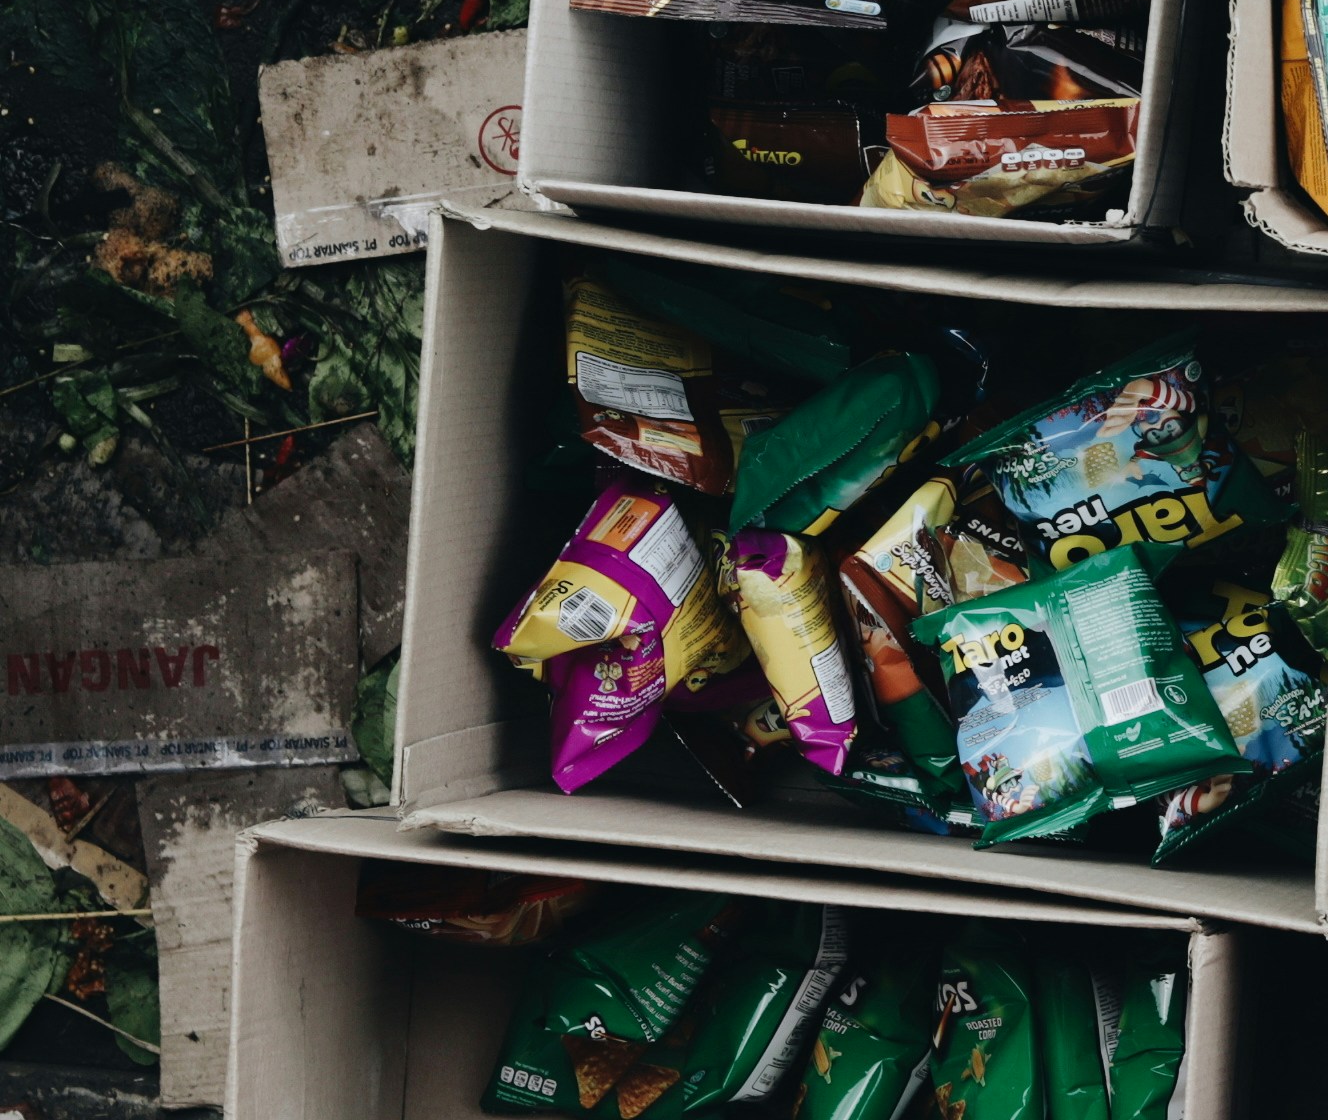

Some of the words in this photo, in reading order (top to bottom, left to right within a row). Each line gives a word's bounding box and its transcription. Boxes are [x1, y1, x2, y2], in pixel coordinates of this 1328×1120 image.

[388, 233, 411, 247] TOP
[287, 246, 313, 262] TOP
[995, 449, 1060, 481] SEAWEED
[1036, 492, 1110, 540] net
[1049, 490, 1244, 571] Taro
[940, 623, 1026, 675] Taro
[1001, 644, 1032, 672] net
[1225, 633, 1272, 675] ne
[6, 643, 220, 697] JANGAN
[159, 743, 182, 756] TOP
[258, 738, 283, 752] TOP
[284, 736, 331, 752] SIANTAR
[331, 735, 349, 749] PT.
[61, 748, 86, 762] TOP
[86, 746, 133, 761] SIANTAR
[965, 1016, 1003, 1031] ROASTED
[977, 1028, 998, 1041] CORN
